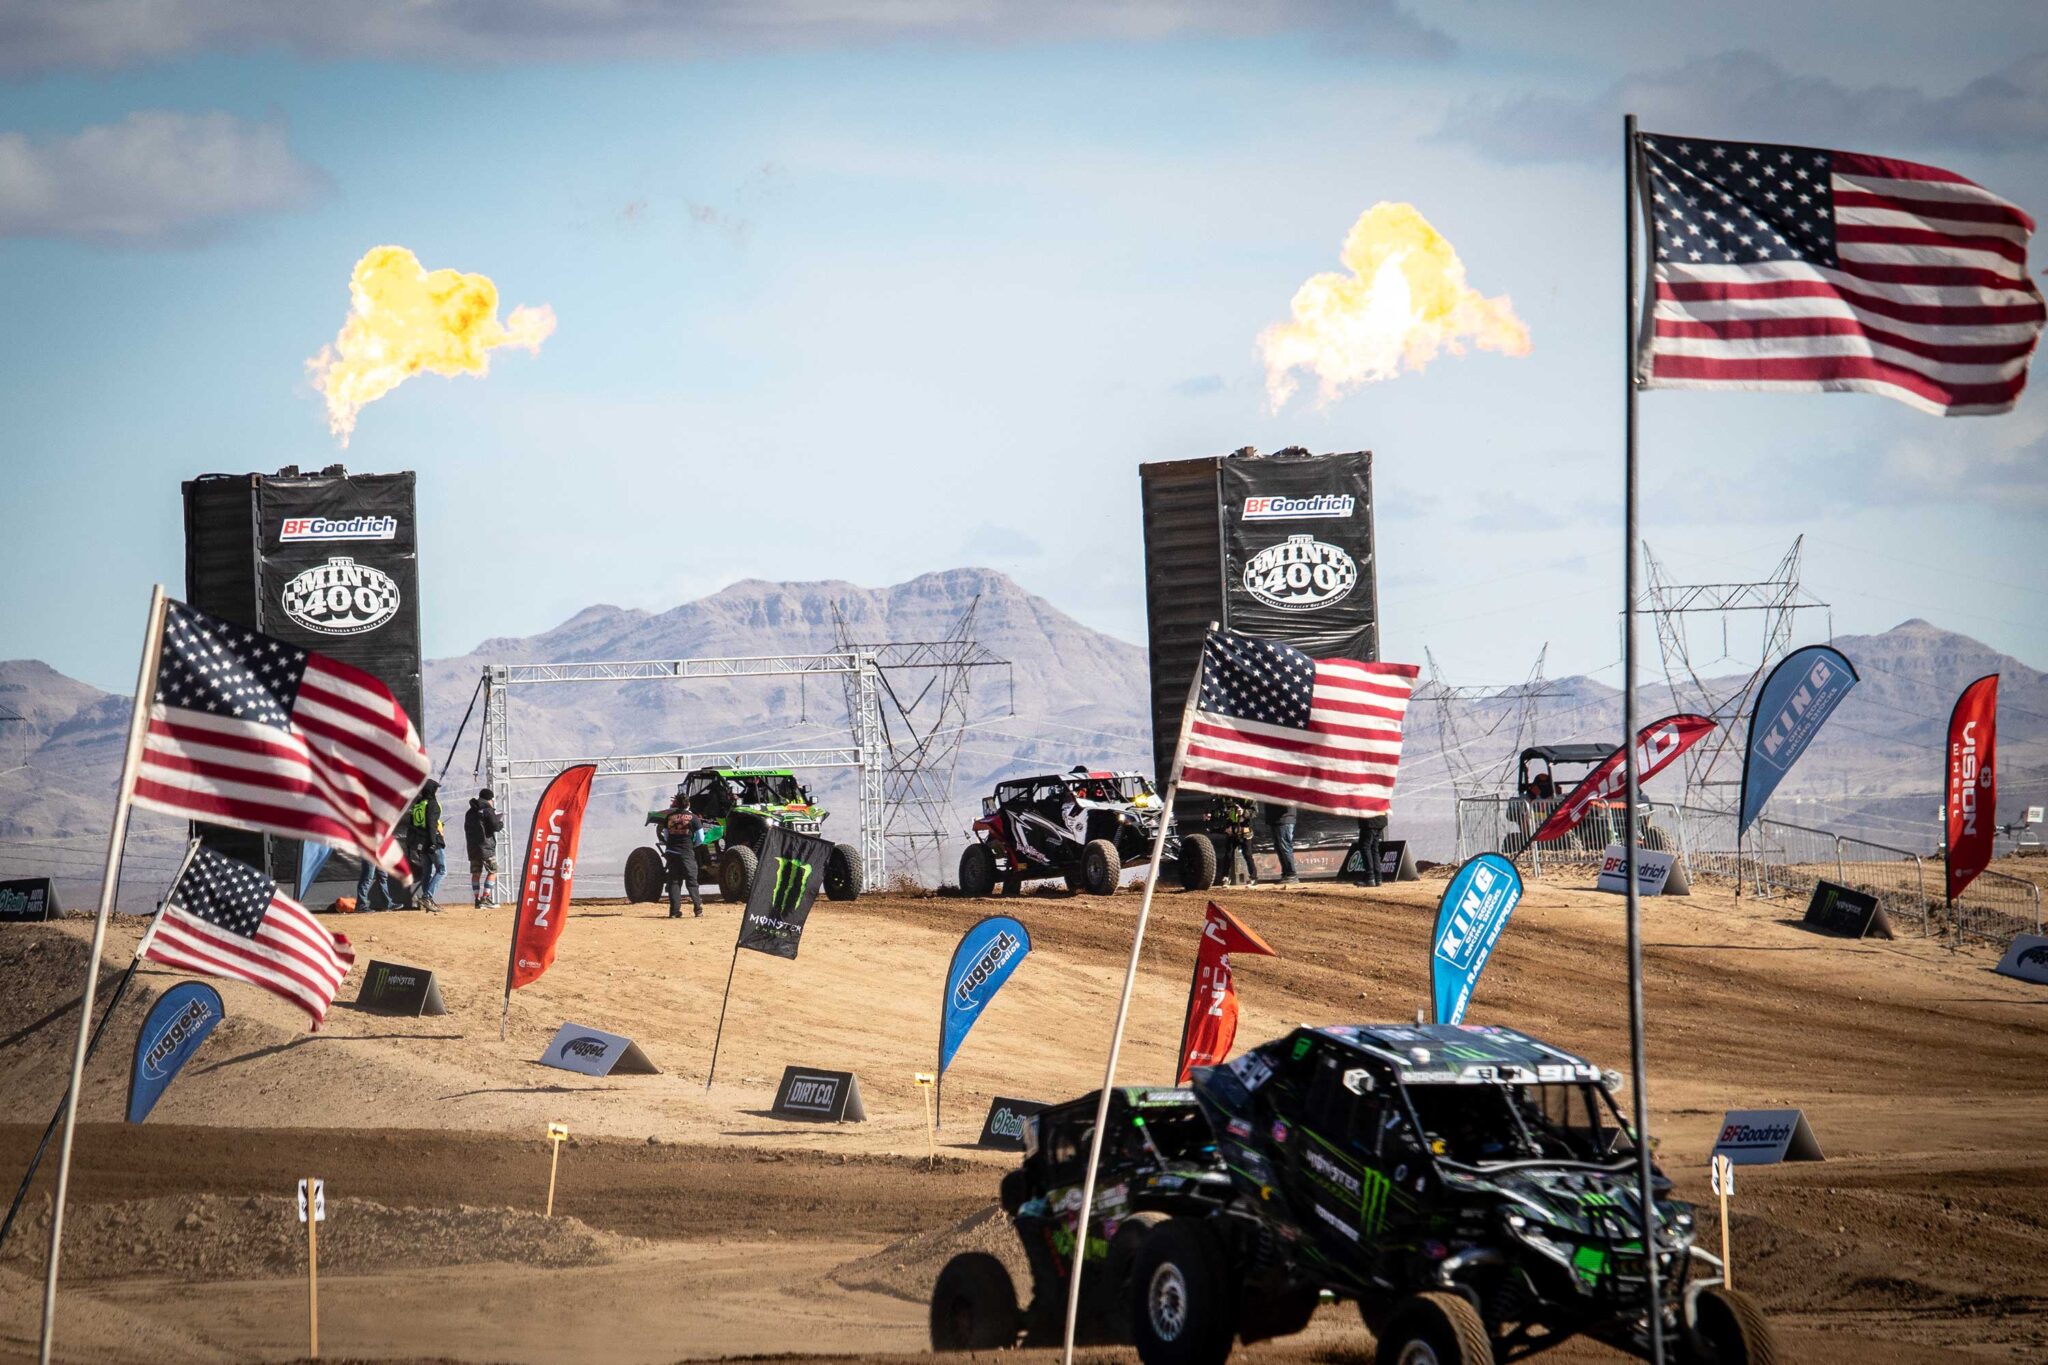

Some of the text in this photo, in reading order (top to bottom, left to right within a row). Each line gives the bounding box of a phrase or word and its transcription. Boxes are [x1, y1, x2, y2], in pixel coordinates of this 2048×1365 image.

[1246, 497, 1352, 512] BFGoodrich
[283, 518, 394, 535] BFGoodrich
[330, 559, 352, 567] THE
[1259, 542, 1342, 574] MINT
[299, 565, 385, 596] MINT
[1263, 562, 1338, 593] 400
[303, 585, 380, 616] 400
[1763, 661, 1831, 757] KING
[1953, 743, 1961, 818] WHEEL
[1962, 720, 1977, 836] VISION
[526, 828, 544, 907] WHEEL
[534, 809, 565, 928] VISION
[749, 913, 802, 934] MONSTER
[1442, 866, 1494, 959] KING
[1466, 946, 1489, 986] RACE
[1486, 888, 1519, 947] SUPPORT
[997, 941, 1020, 969] radios
[186, 1009, 212, 1038] radios
[789, 1081, 832, 1105] DIRT CO.
[1721, 1124, 1790, 1142] BFGoodrich
